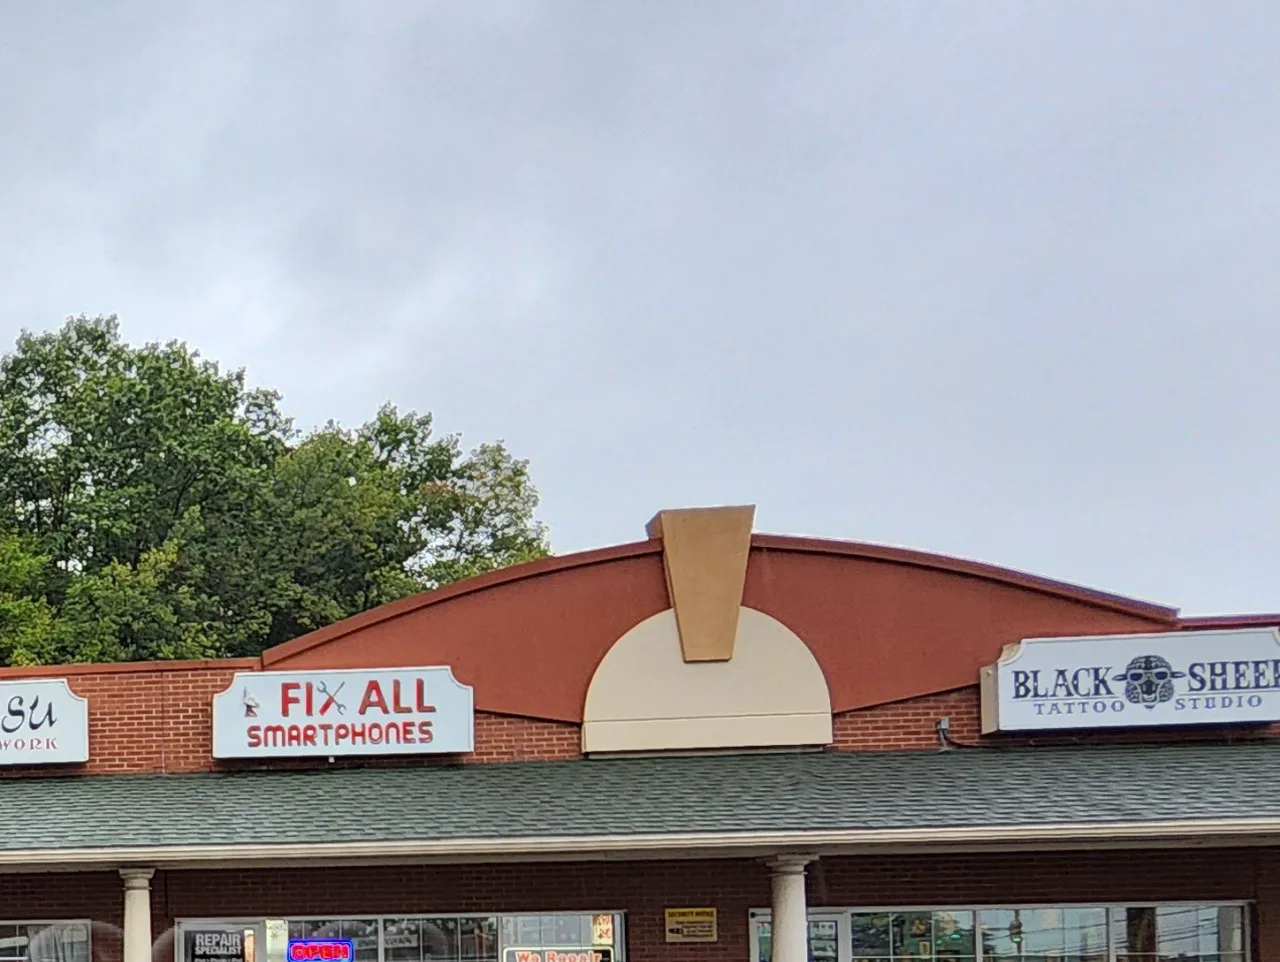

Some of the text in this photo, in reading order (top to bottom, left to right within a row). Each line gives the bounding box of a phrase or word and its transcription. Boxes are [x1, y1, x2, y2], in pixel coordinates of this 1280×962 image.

[1012, 666, 1115, 699] BLACK
[281, 678, 436, 717] FIX ALL
[1033, 695, 1263, 715] TATTOO STUDIO
[247, 721, 433, 748] SMARTPHONES
[195, 933, 241, 946] REPAIR
[195, 946, 242, 955] SPECIALIST
[290, 944, 350, 960] OPEN
